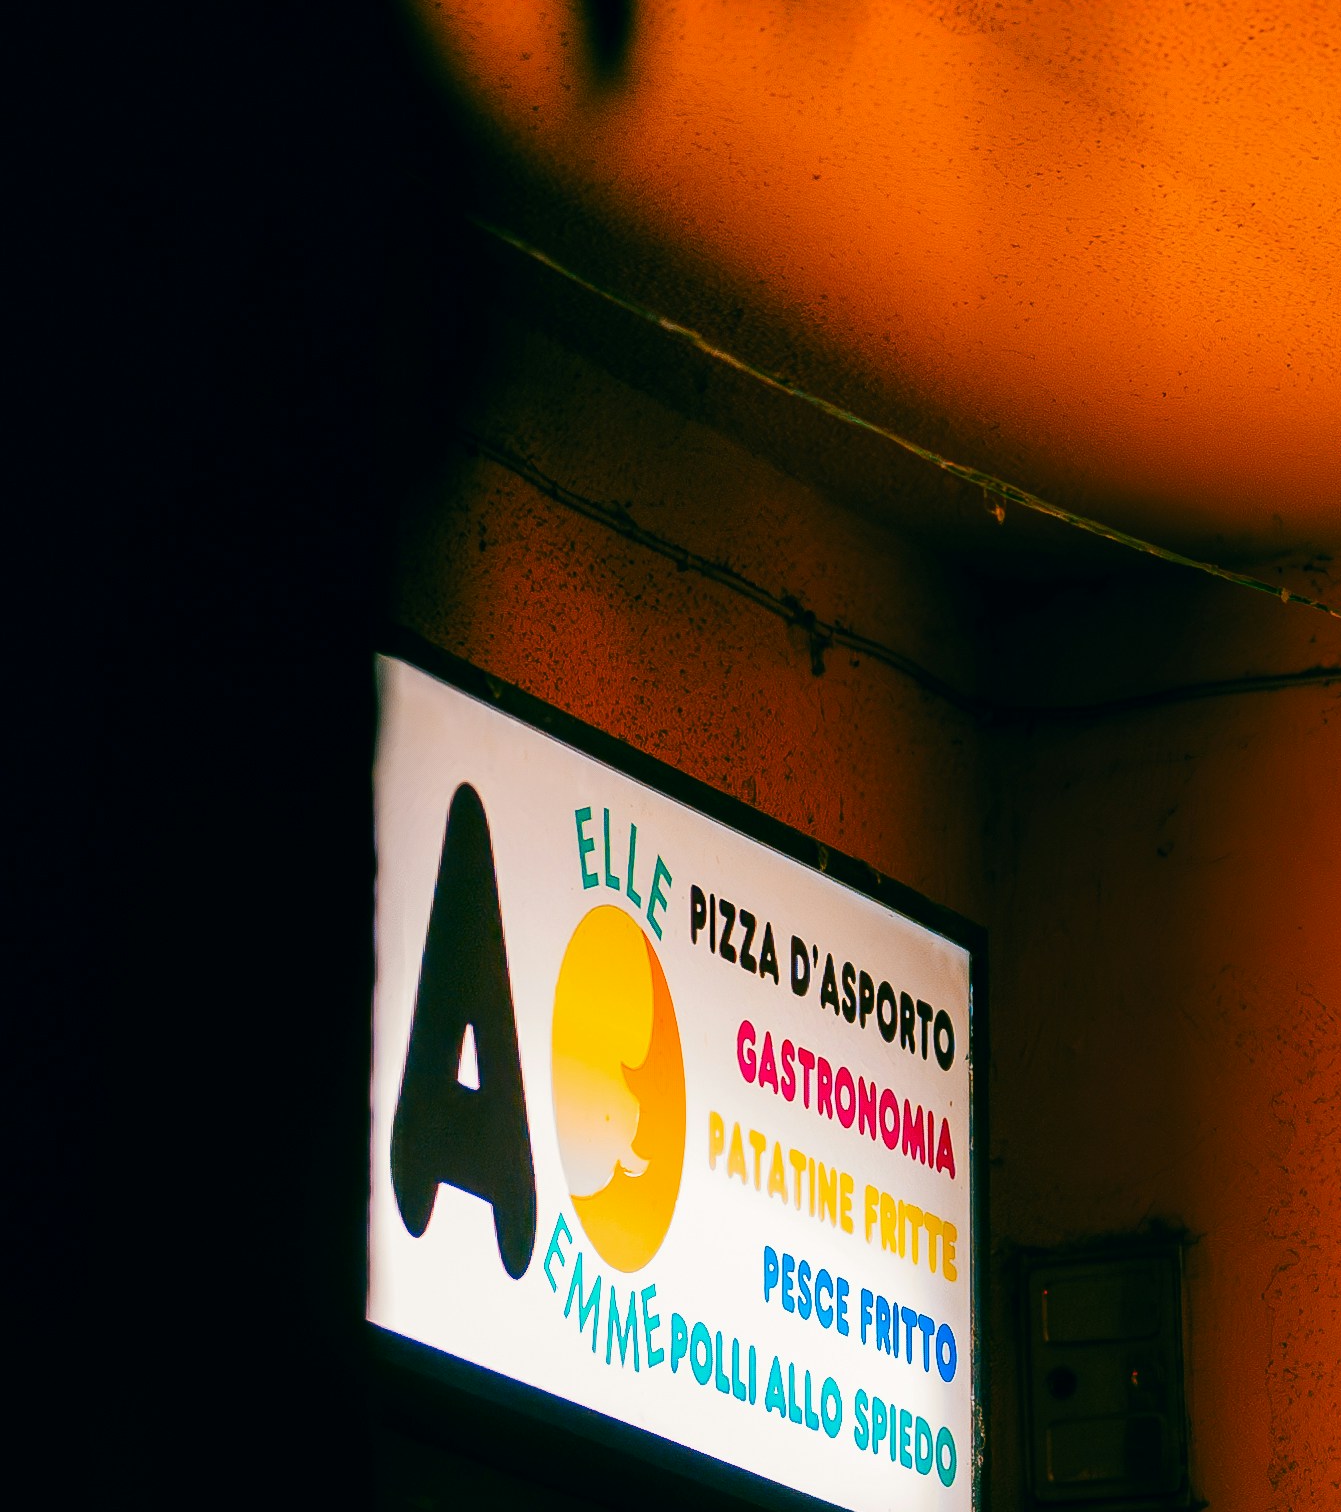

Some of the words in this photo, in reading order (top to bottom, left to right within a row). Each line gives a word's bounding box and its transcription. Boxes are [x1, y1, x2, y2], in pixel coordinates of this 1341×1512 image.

[575, 805, 673, 942] ELLE
[690, 884, 779, 986] PIZZA
[790, 934, 955, 1072] D'ASPORTO
[737, 1020, 955, 1180] GASTRONOMIA
[709, 1110, 854, 1235] PATATINE
[864, 1184, 958, 1283] FRITTE
[543, 1212, 665, 1373] EMME
[763, 1245, 850, 1337] PESCE
[860, 1288, 958, 1383] FRITTO
[671, 1313, 757, 1406] POLLI
[764, 1355, 843, 1439] ALLO
[853, 1388, 958, 1488] SPIEDO
